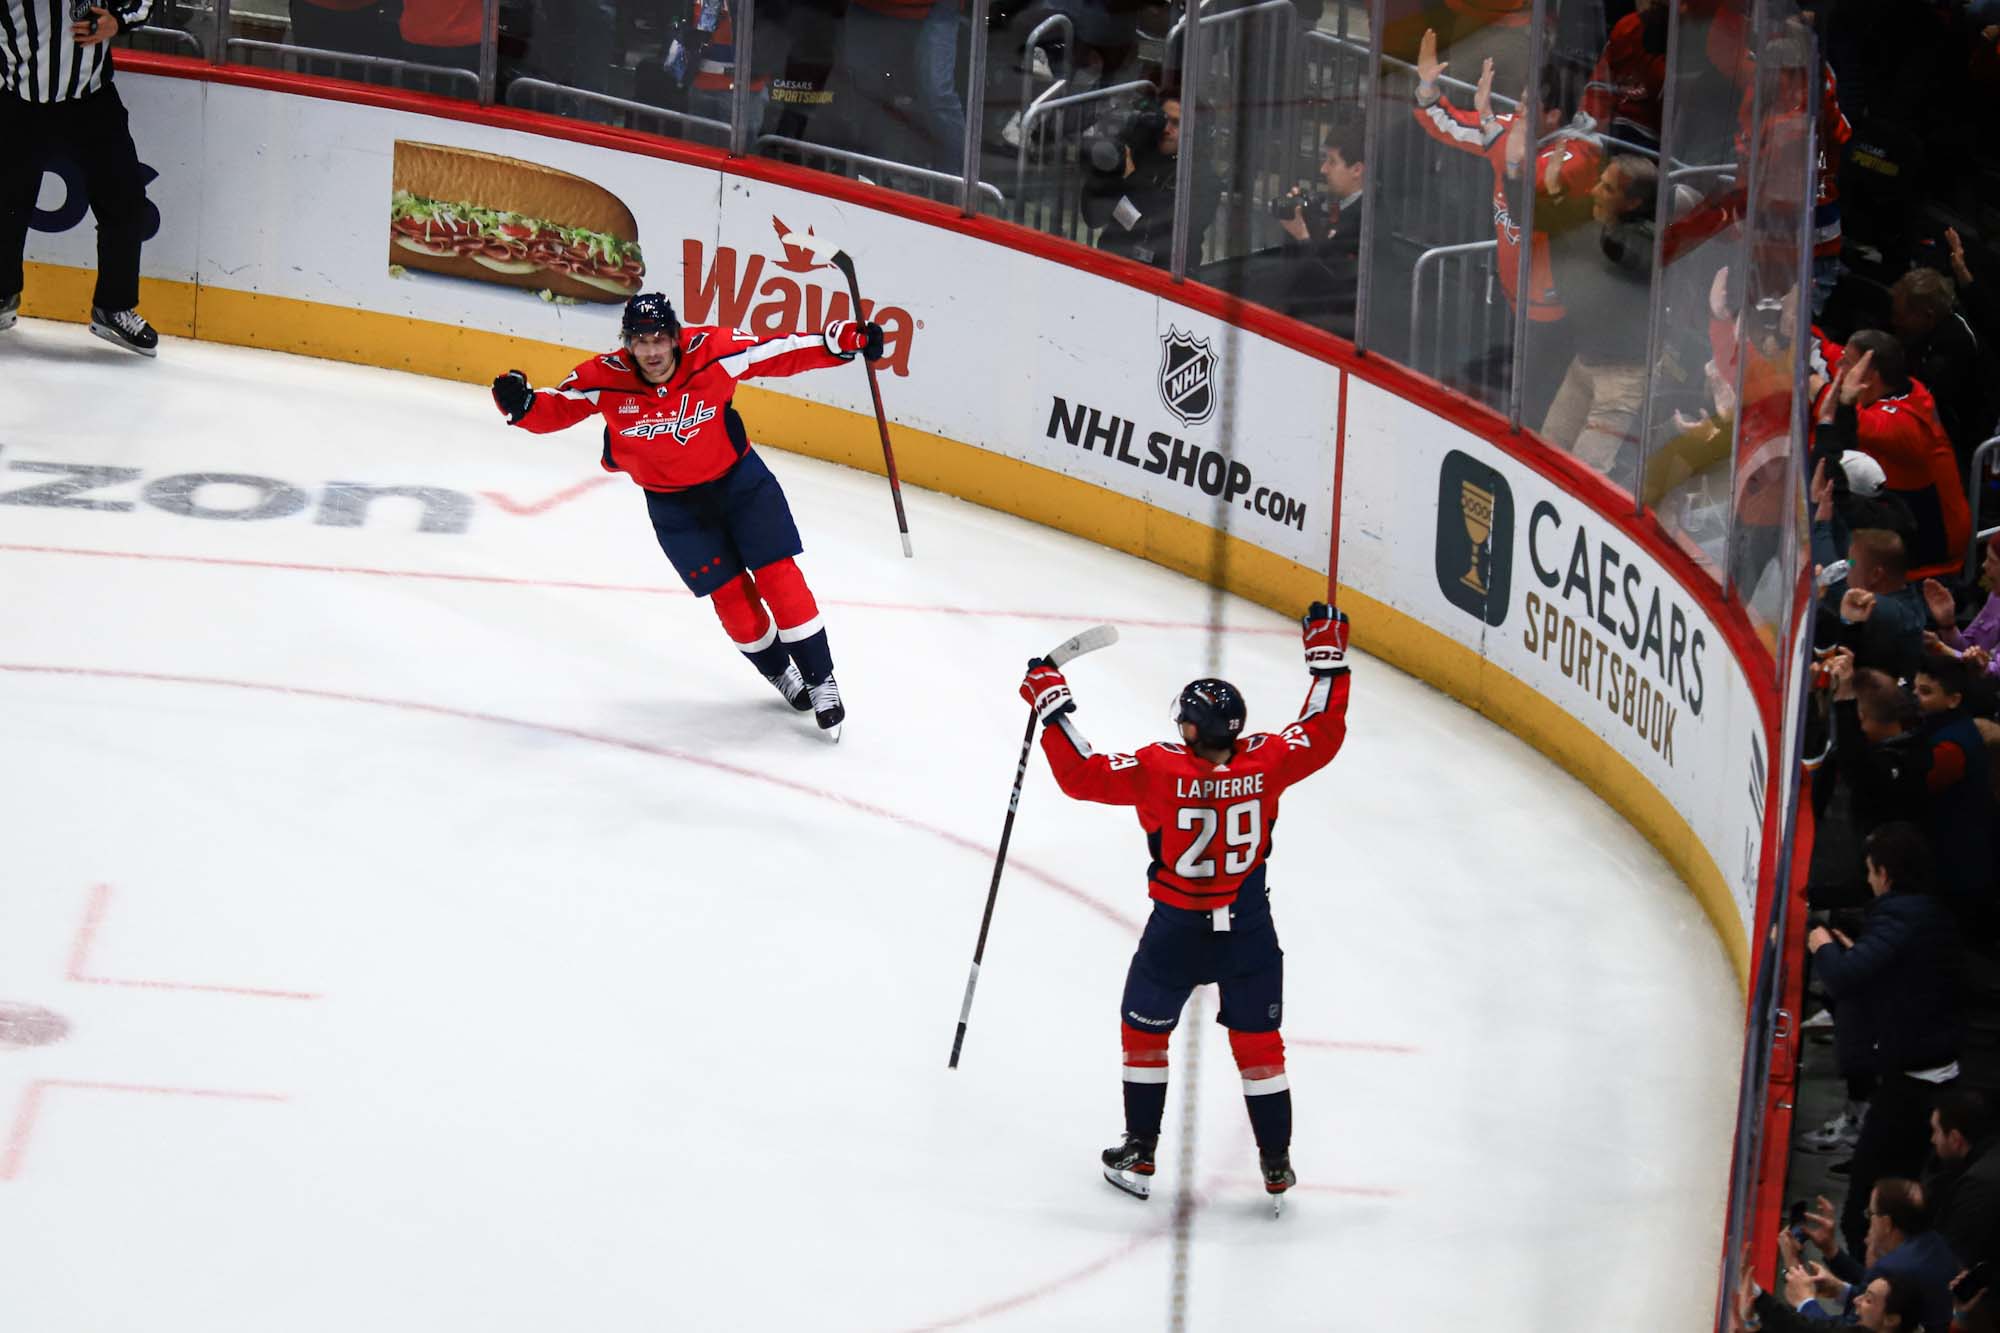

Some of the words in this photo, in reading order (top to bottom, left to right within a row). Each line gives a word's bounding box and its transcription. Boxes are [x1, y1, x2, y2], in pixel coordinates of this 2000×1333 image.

[773, 79, 813, 90] CAESARS
[682, 238, 914, 377] Wawa
[1170, 361, 1208, 401] NHL
[0, 459, 476, 535] zon
[1046, 395, 1307, 532] NHLSHOP.COM
[1528, 499, 1706, 717] CAESARS
[1304, 650, 1345, 664] CCM
[1523, 591, 1678, 769] SPORTSBOOK
[1176, 773, 1264, 799] LAPIERRE
[1175, 798, 1262, 879] 29
